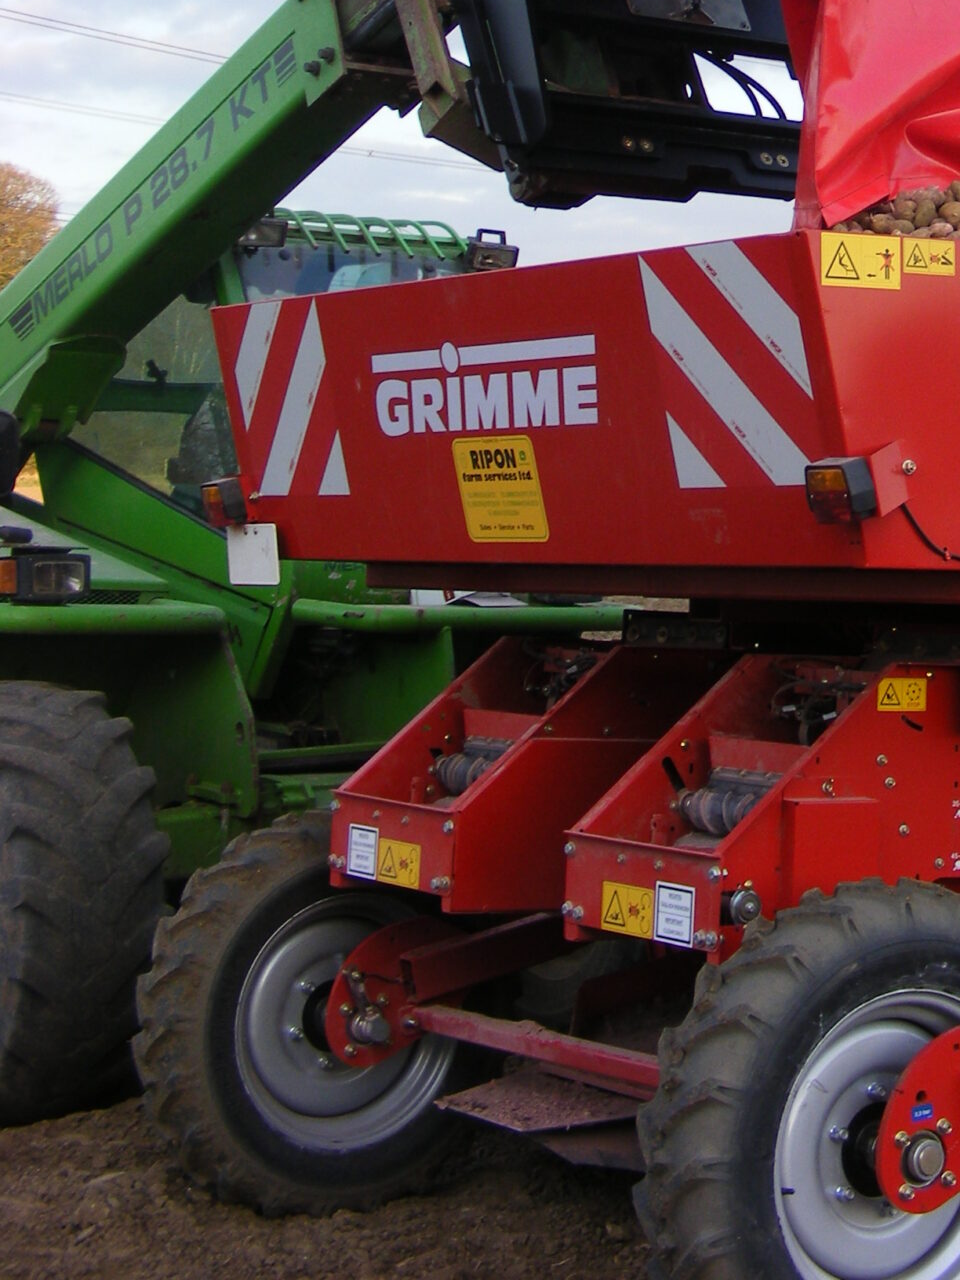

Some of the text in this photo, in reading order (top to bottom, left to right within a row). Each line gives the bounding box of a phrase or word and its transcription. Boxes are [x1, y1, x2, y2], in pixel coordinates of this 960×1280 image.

[31, 61, 272, 325] MERLO P 28.7 KT
[375, 341, 599, 437] GRIMME
[462, 472, 483, 482] farm
[484, 471, 518, 481] services
[469, 448, 517, 469] RIPON
